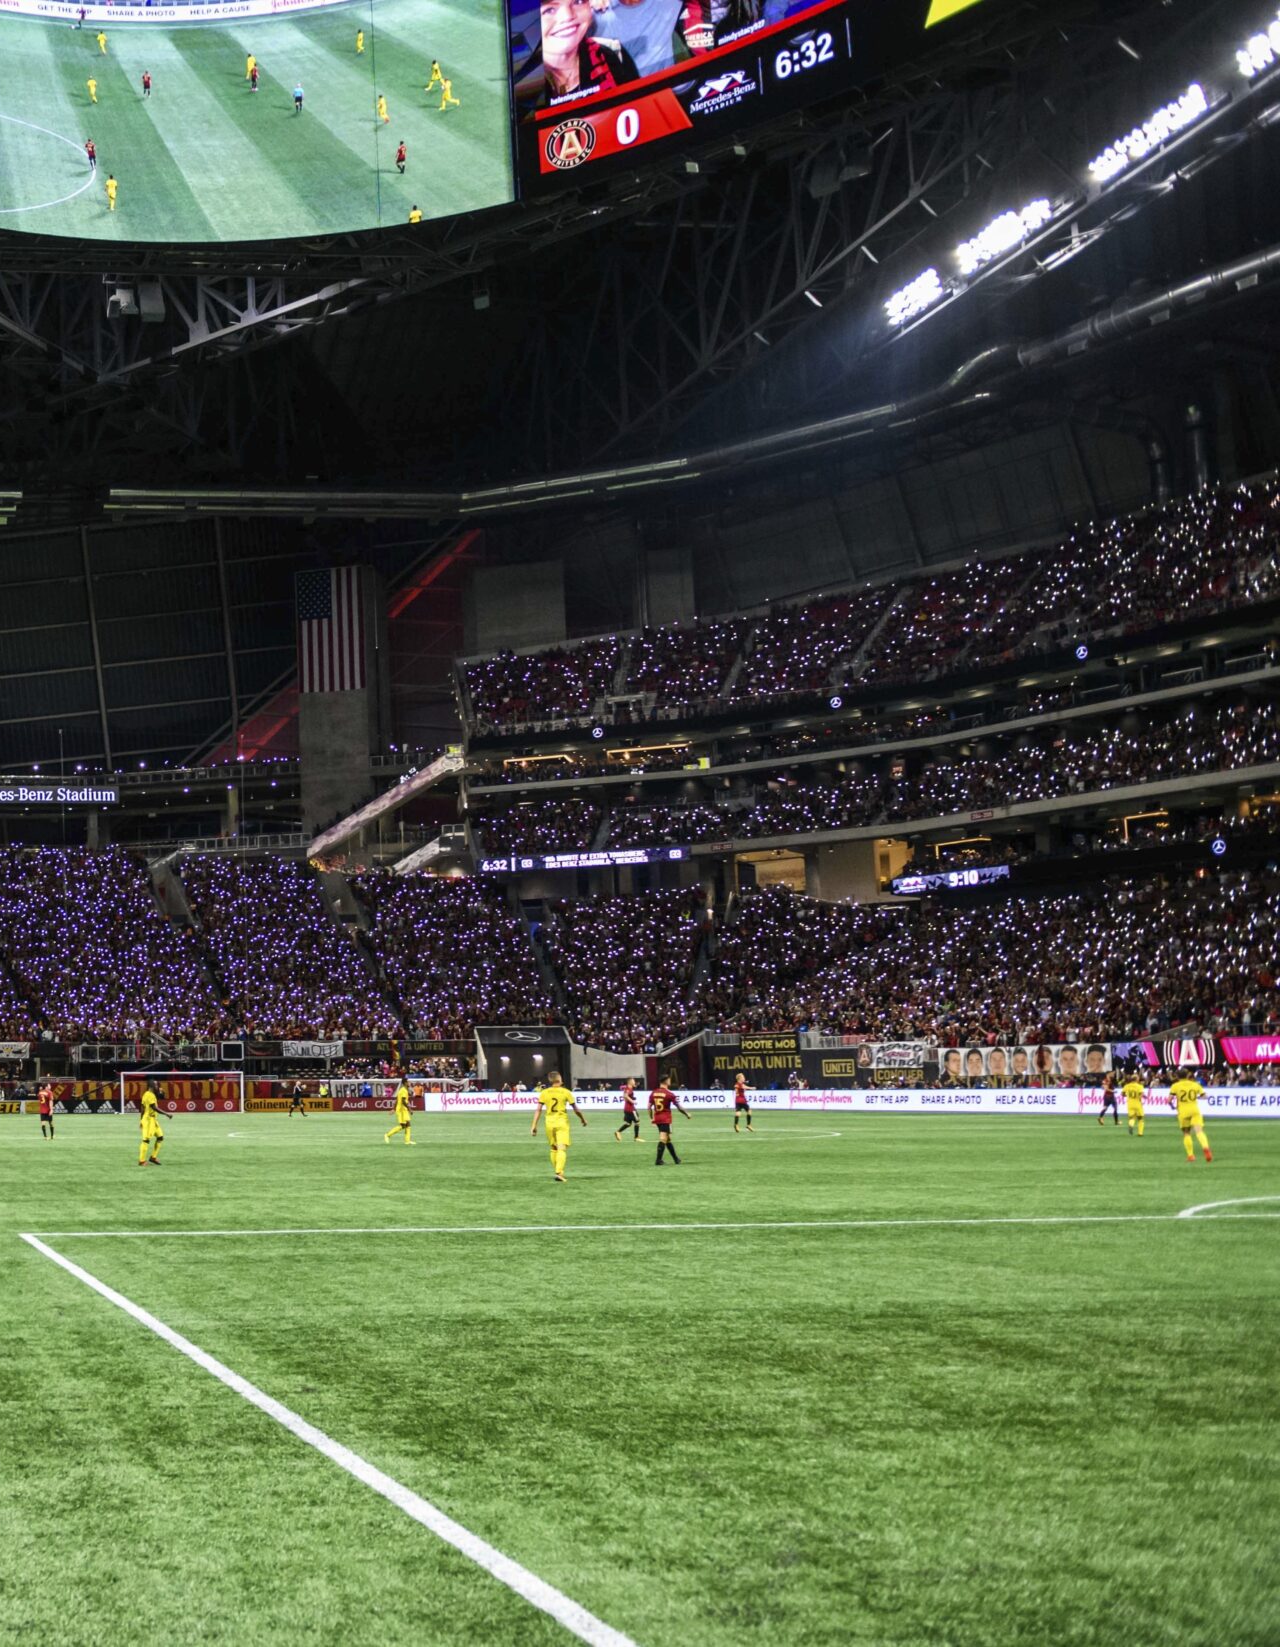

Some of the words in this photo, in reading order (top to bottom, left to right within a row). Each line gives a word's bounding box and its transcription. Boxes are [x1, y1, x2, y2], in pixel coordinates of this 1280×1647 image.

[222, 5, 251, 13] CAUSE
[775, 32, 834, 79] 6:32
[689, 81, 757, 115] Mercedes-Benz
[704, 95, 743, 115] STADIUM
[552, 119, 588, 138] ATLANTA
[616, 108, 640, 145] 0
[550, 156, 581, 168] UNITED
[56, 787, 116, 802] Stadium
[482, 859, 508, 871] 6:32
[948, 870, 980, 887] 9:10
[414, 1043, 444, 1051] UNITED
[775, 1039, 796, 1049] MOB
[714, 1055, 763, 1070] ATLANTA
[876, 1055, 923, 1068] FUTBOL
[824, 1063, 852, 1073] UNITE
[591, 1096, 609, 1104] THE
[683, 1095, 690, 1104] A
[692, 1095, 726, 1104] PHOTO
[865, 1096, 879, 1104] GET
[880, 1096, 893, 1104] THE
[895, 1096, 909, 1104] APP
[921, 1096, 946, 1104] SHARE
[947, 1096, 953, 1104] A
[954, 1096, 982, 1104] PHOTO
[995, 1096, 1017, 1104] HELP
[1018, 1096, 1024, 1104] A
[1027, 1096, 1057, 1104] CAUSE
[1179, 1089, 1197, 1102] 20
[1207, 1096, 1231, 1106] GET
[1234, 1096, 1257, 1106] THE
[342, 1101, 367, 1109] Audi
[550, 1097, 559, 1113] 2
[654, 1099, 665, 1112] 15
